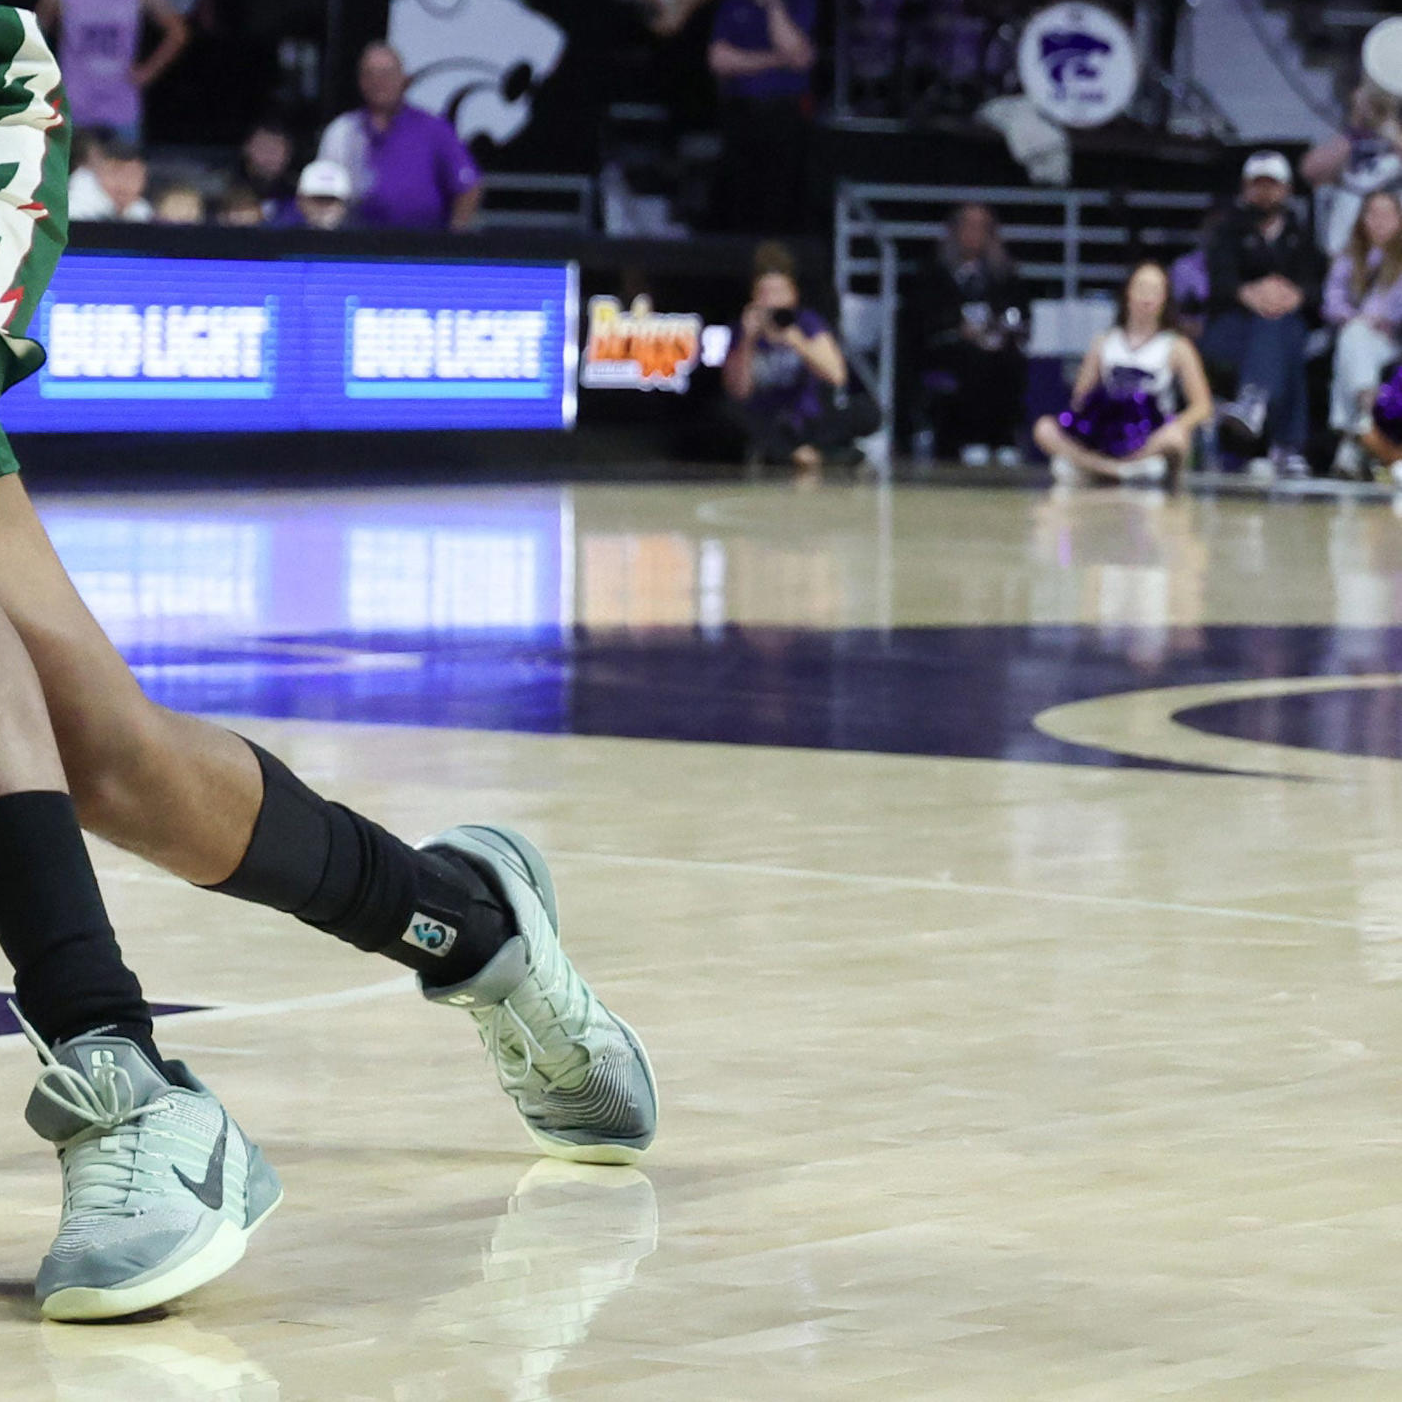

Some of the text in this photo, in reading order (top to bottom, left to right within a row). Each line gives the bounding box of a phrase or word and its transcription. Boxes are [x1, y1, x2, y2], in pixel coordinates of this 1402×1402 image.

[48, 303, 269, 379] BUD LIGHT
[352, 307, 436, 379] BUD
[435, 309, 546, 380] LIGHT
